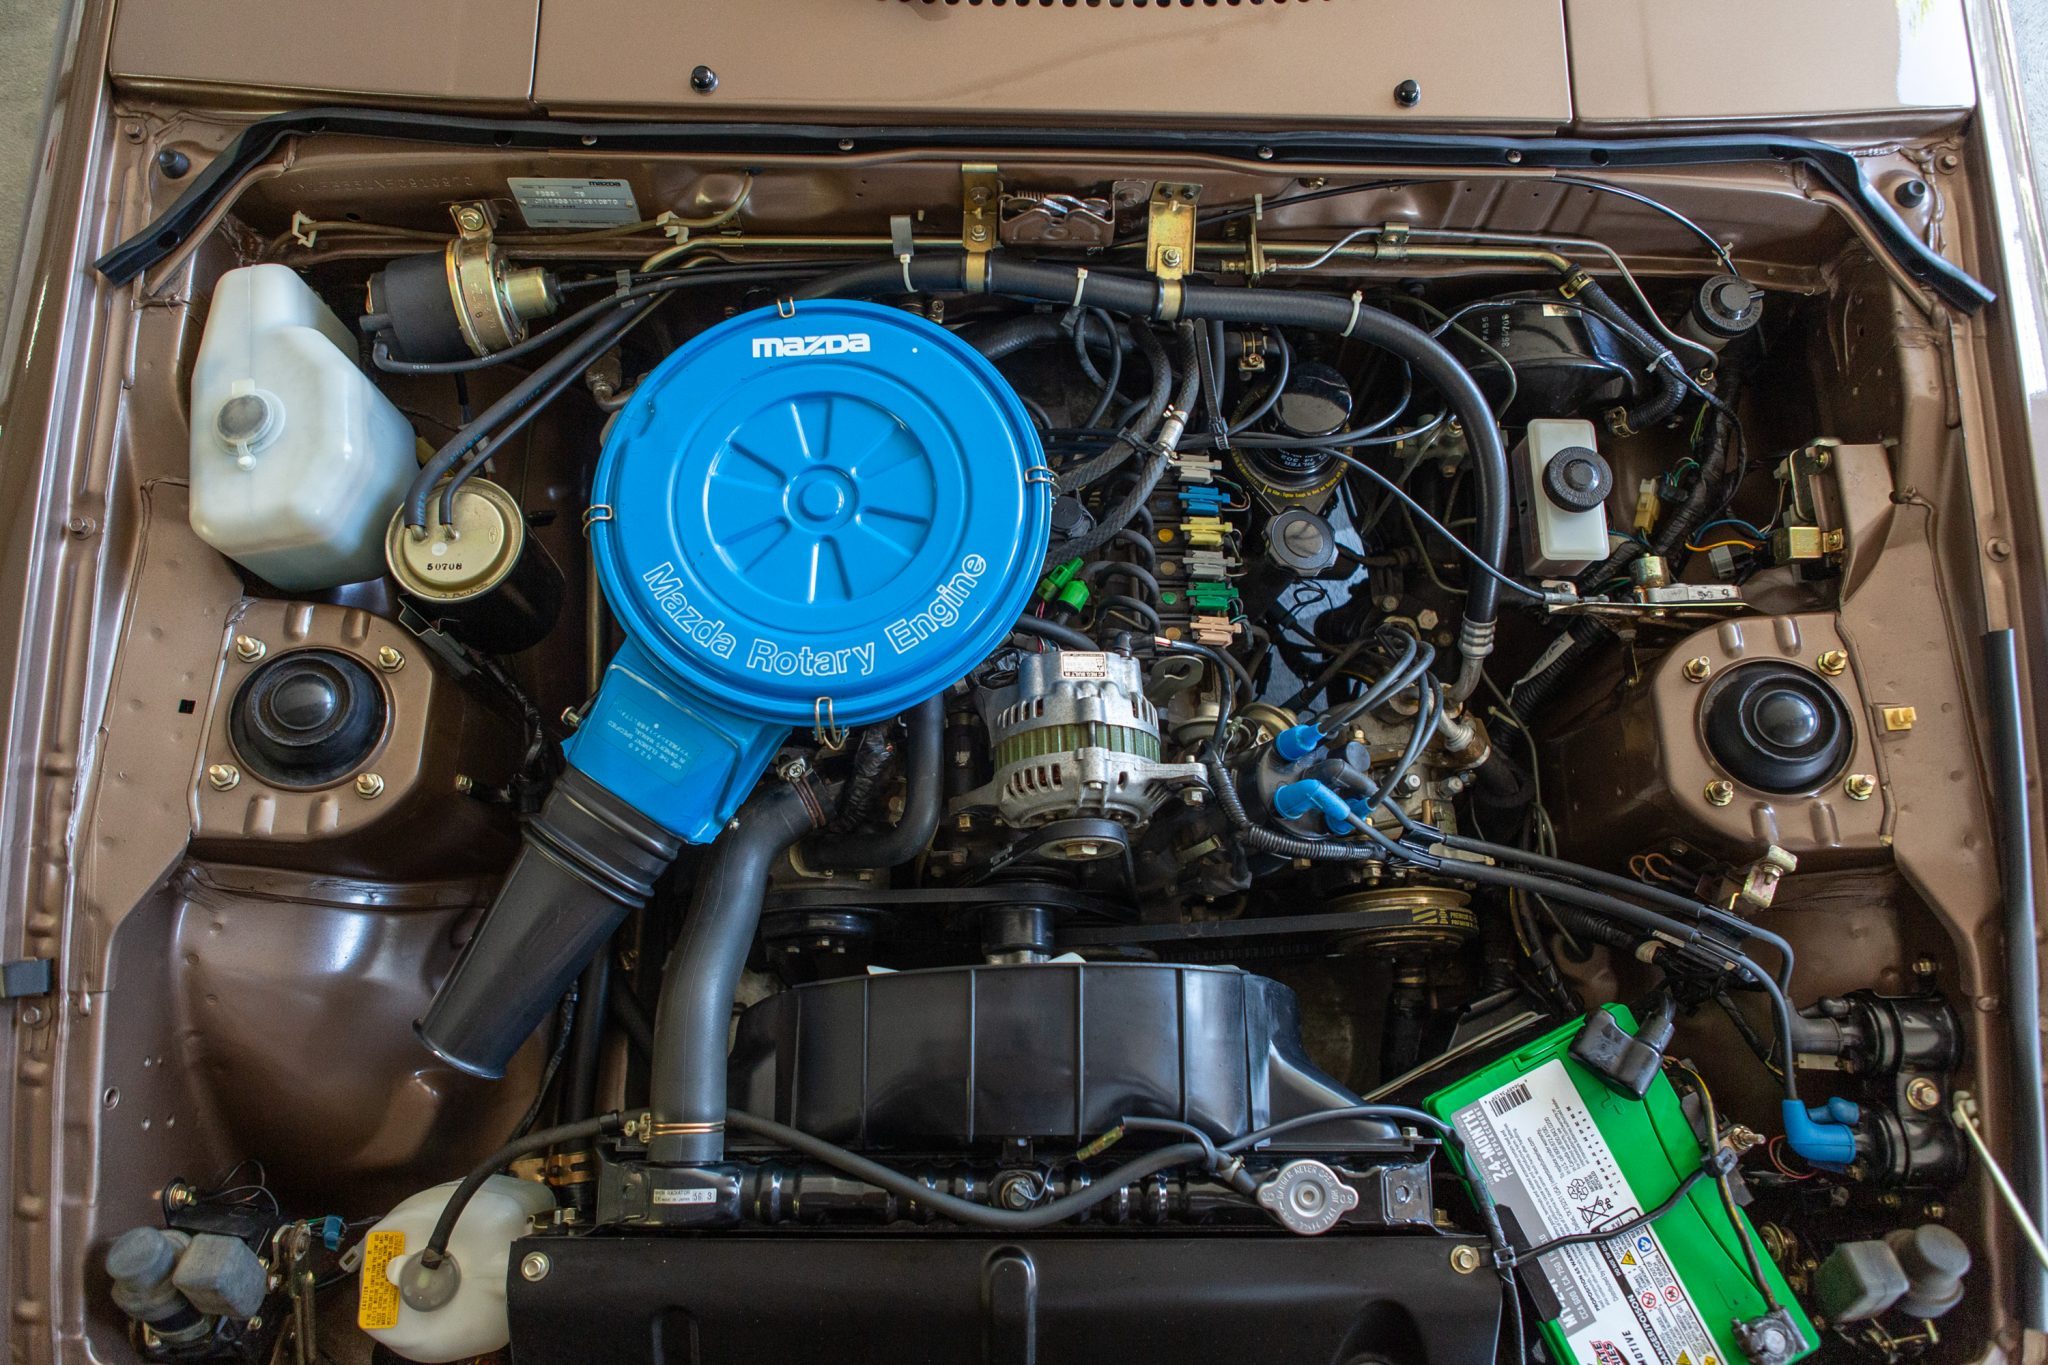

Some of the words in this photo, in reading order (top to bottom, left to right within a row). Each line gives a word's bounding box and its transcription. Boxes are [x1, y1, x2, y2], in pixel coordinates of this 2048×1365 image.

[643, 561, 737, 659] Mazda
[746, 638, 875, 676] Rotary
[884, 553, 987, 655] Engine
[607, 719, 633, 739] SPECIFIED
[633, 727, 654, 744] MANUAL
[634, 737, 658, 755] ELEMENT
[659, 752, 670, 762] THE
[670, 759, 682, 769] USE
[678, 756, 685, 764] IN
[1472, 1105, 1504, 1156] REPLACEMENT
[1459, 1109, 1508, 1182] 24-MONTH
[1500, 1156, 1514, 1175] FREE
[1603, 1197, 1613, 1210] Pb
[1576, 1304, 1589, 1319] CCA
